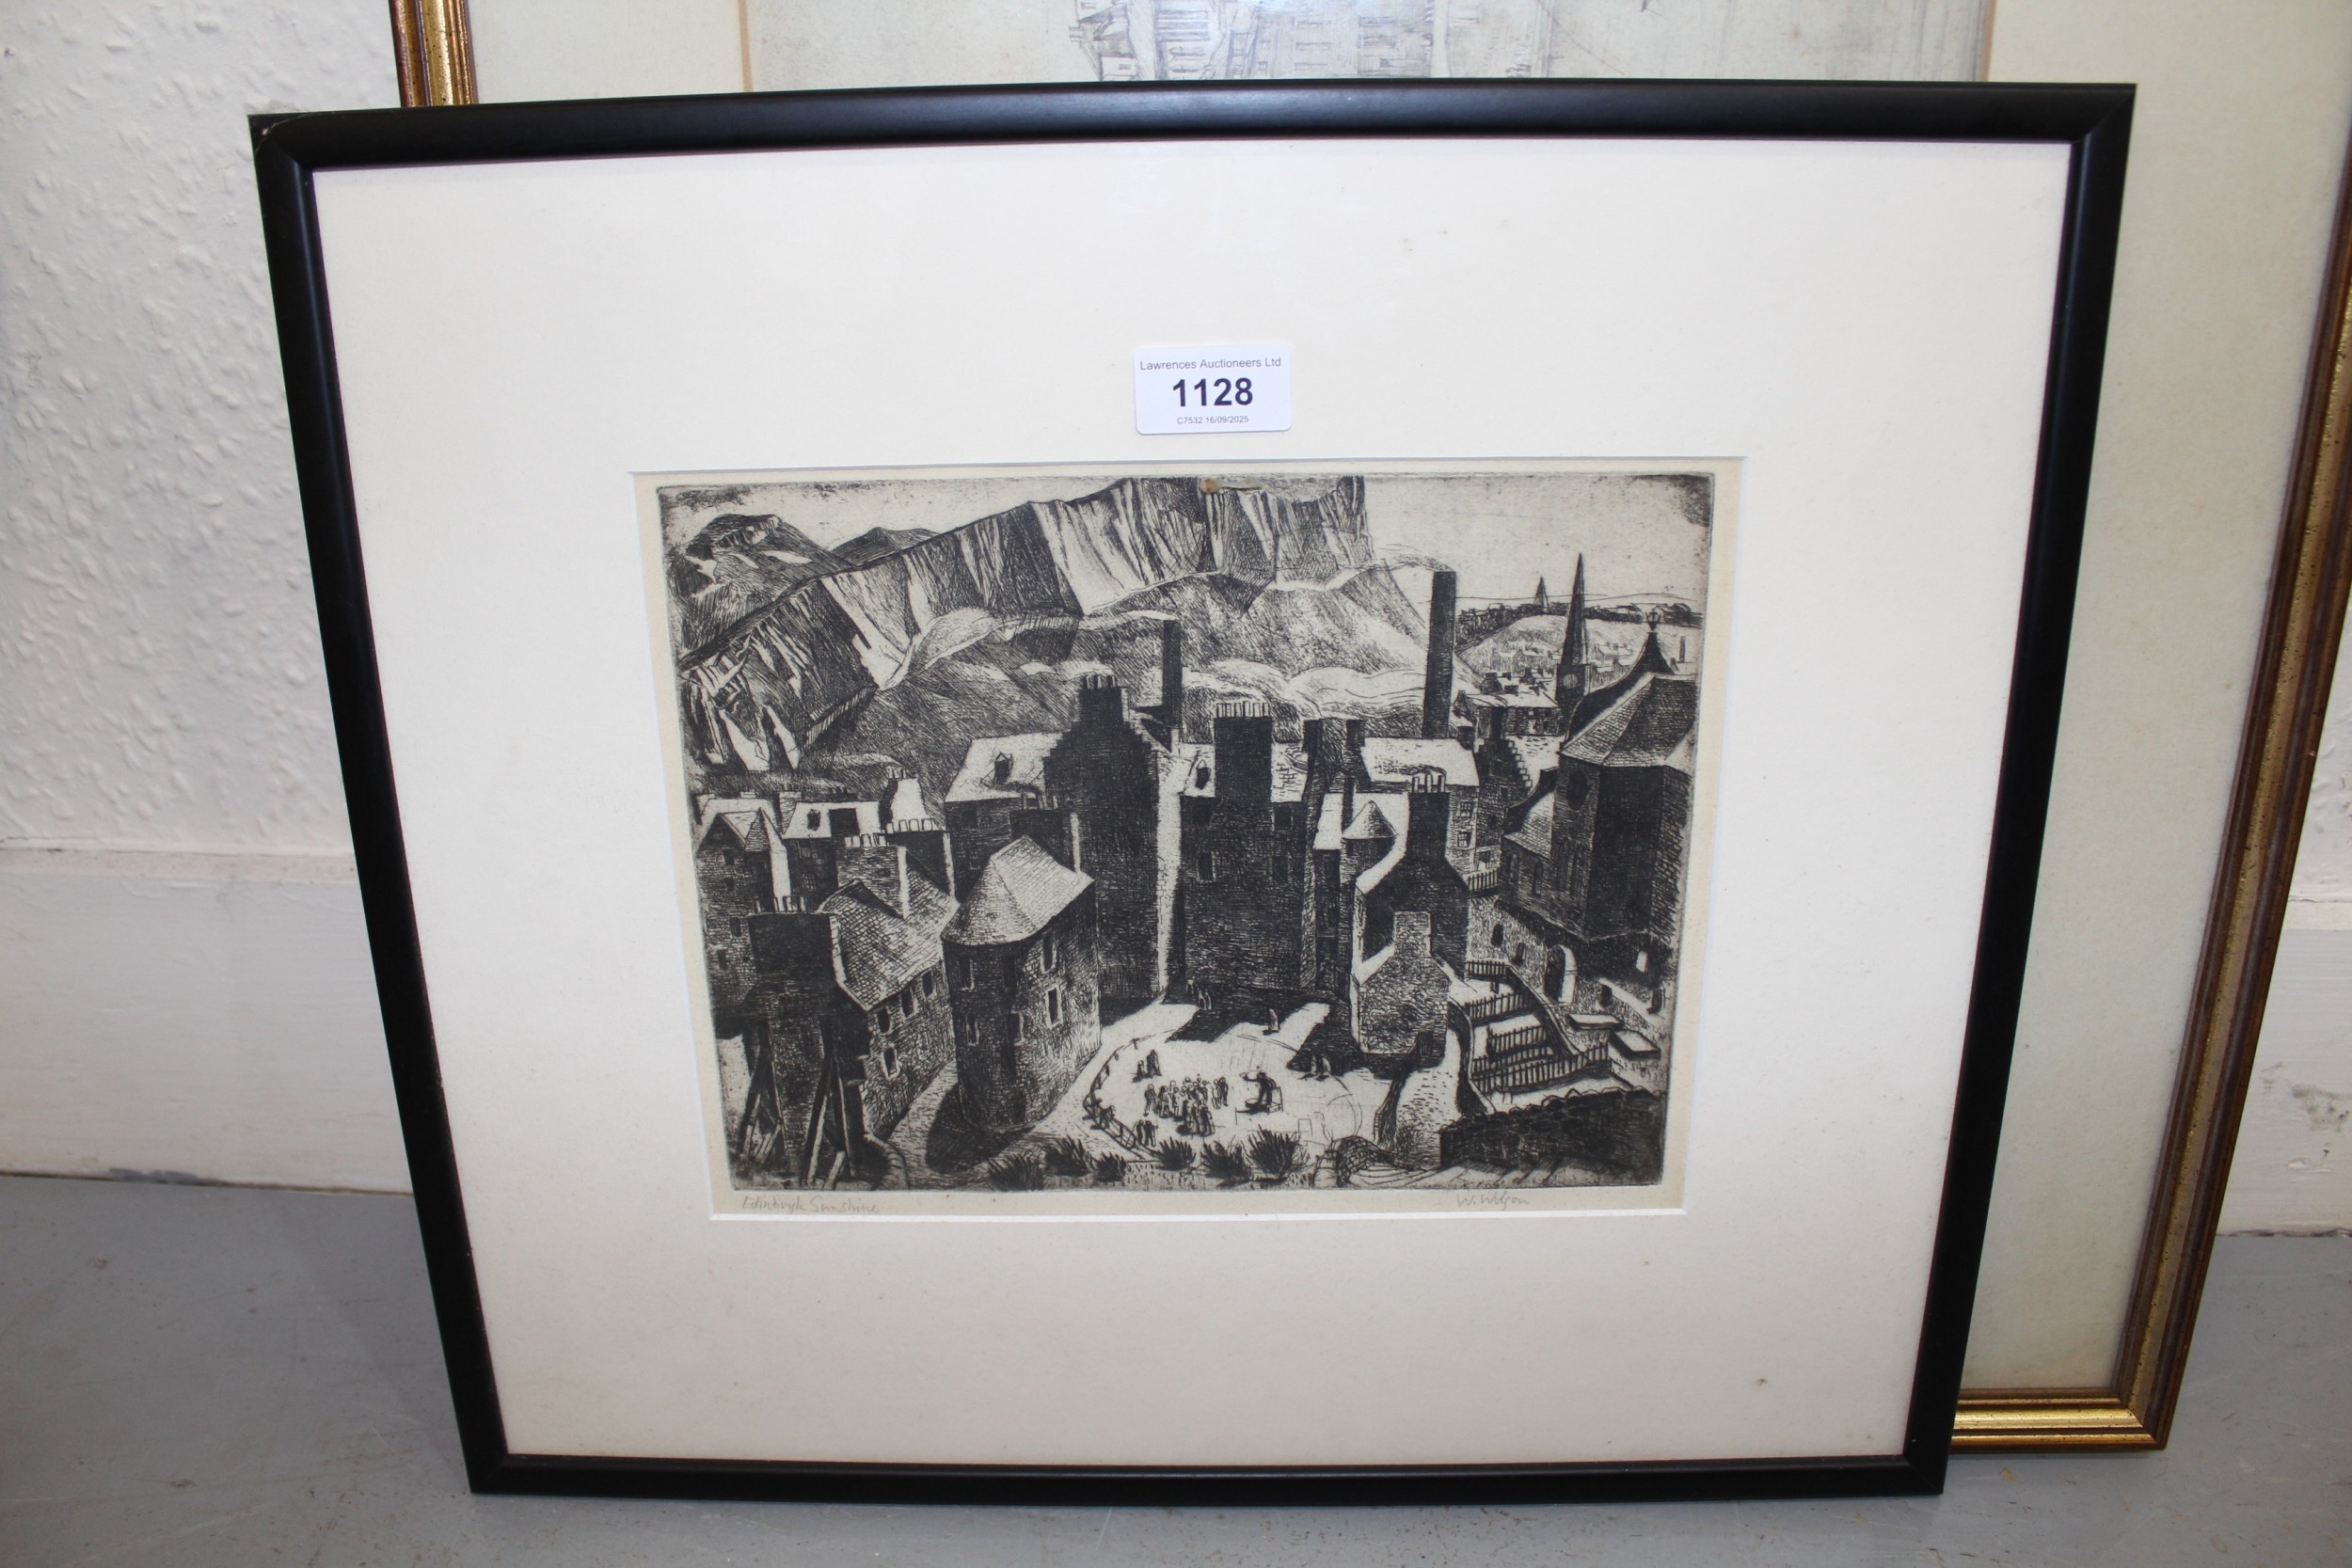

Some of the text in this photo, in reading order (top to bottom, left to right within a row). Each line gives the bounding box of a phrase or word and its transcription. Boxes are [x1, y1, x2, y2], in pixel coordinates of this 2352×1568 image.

[1139, 357, 1281, 371] Lawrences Auctioneers Ltd
[1172, 377, 1253, 407] 1128
[1205, 416, 1249, 424] 16/09/2025
